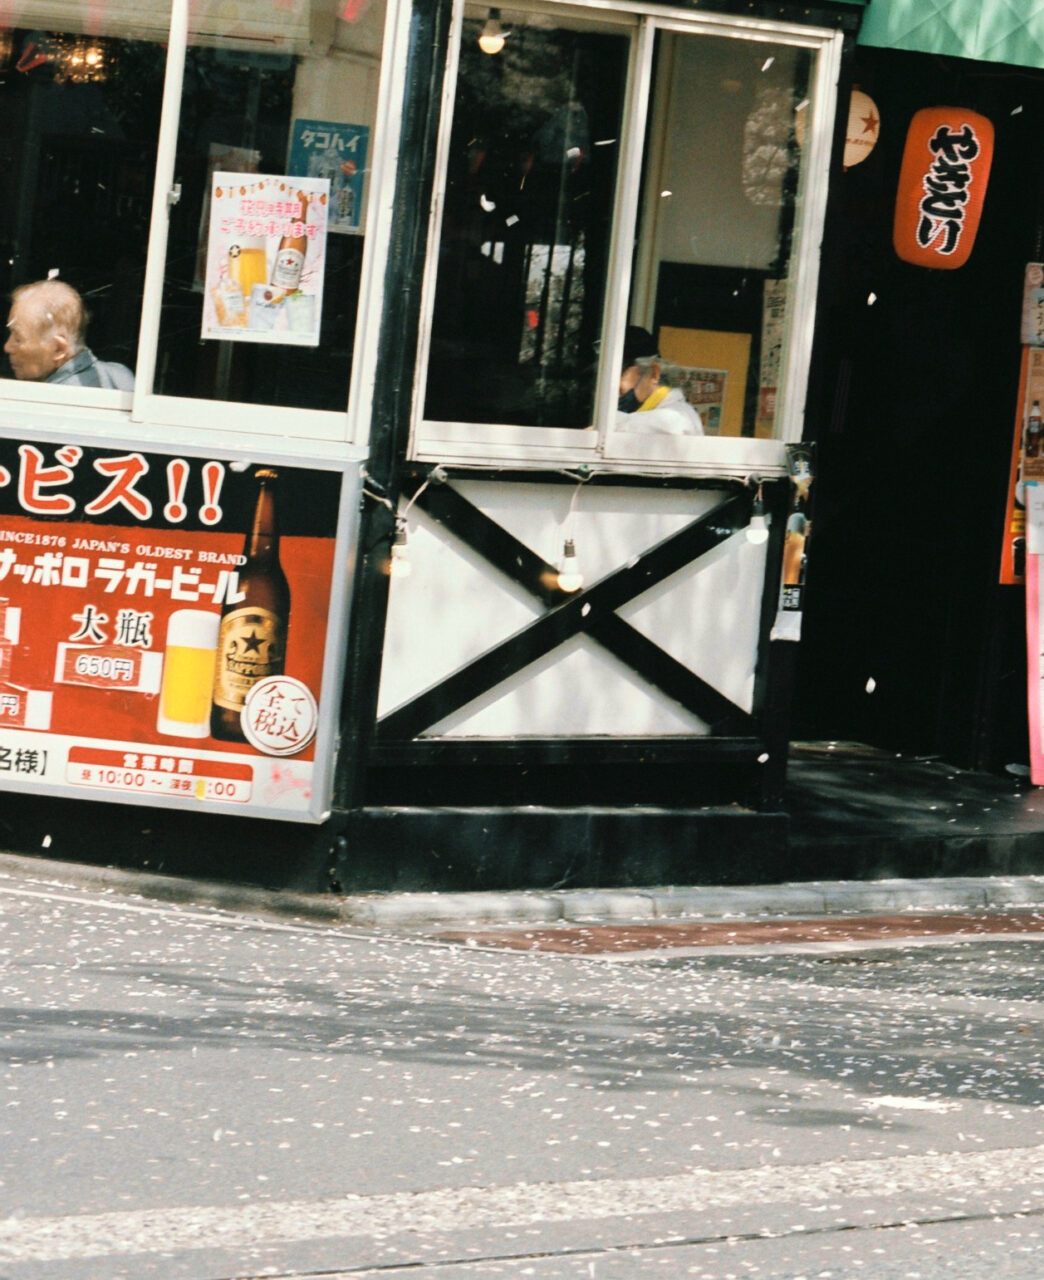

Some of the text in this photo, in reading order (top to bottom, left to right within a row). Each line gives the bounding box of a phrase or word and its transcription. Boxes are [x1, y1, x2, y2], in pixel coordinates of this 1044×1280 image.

[300, 130, 361, 153] タコハイ
[916, 123, 980, 256] やきとり
[72, 537, 131, 554] JAPAN'S
[136, 545, 193, 561] OLDEST
[198, 551, 248, 567] BRAND
[69, 604, 154, 648] 大瓶
[75, 654, 134, 682] 650円
